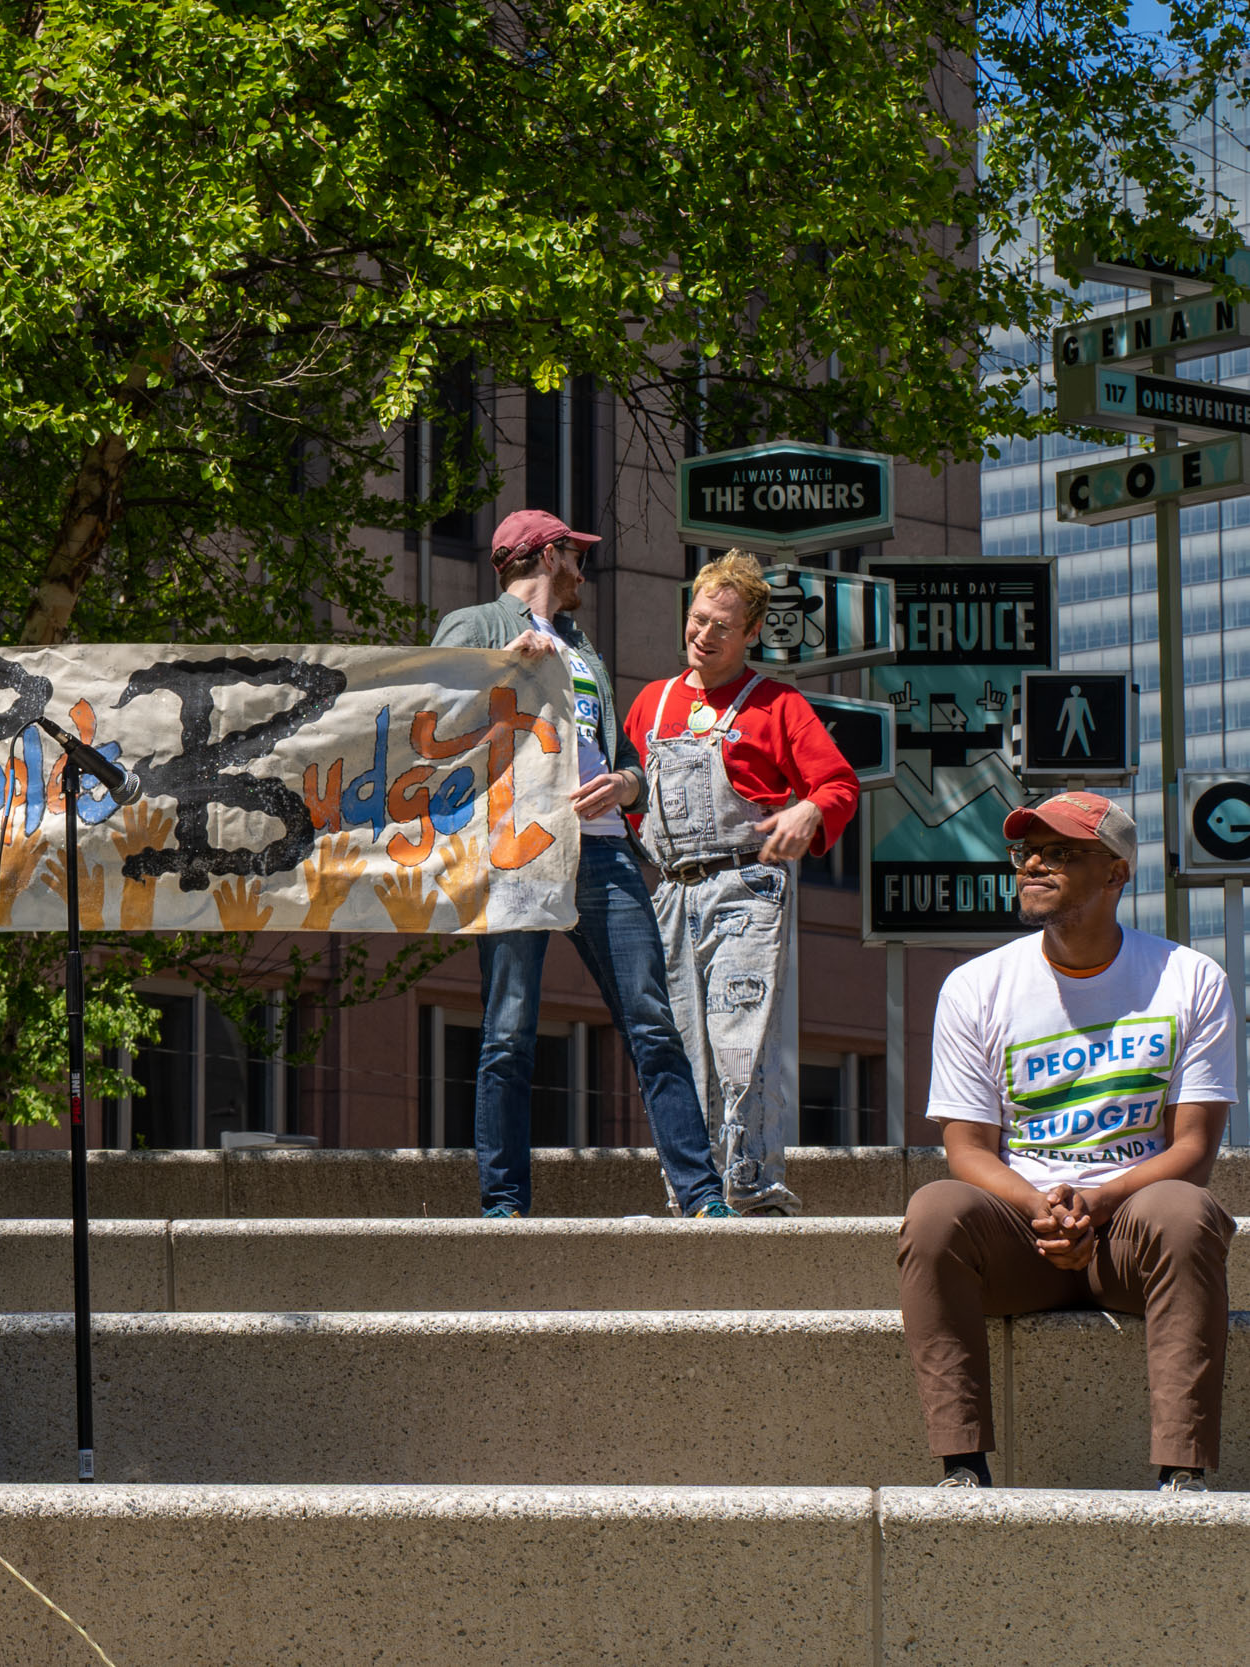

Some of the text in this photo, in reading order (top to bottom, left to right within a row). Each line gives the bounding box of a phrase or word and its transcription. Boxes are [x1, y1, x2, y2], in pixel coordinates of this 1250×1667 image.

[1104, 383, 1127, 403] 117
[733, 467, 832, 483] ALWAYS WATCH
[701, 483, 865, 512] THE CORNERS
[920, 582, 996, 595] SAME DAY
[111, 655, 561, 893] Budget
[1026, 1034, 1166, 1081] PEOPLE'S
[71, 1072, 82, 1124] PROLINE
[1027, 1100, 1158, 1141] BUDGET
[1025, 1140, 1145, 1164] CLEVELAND
